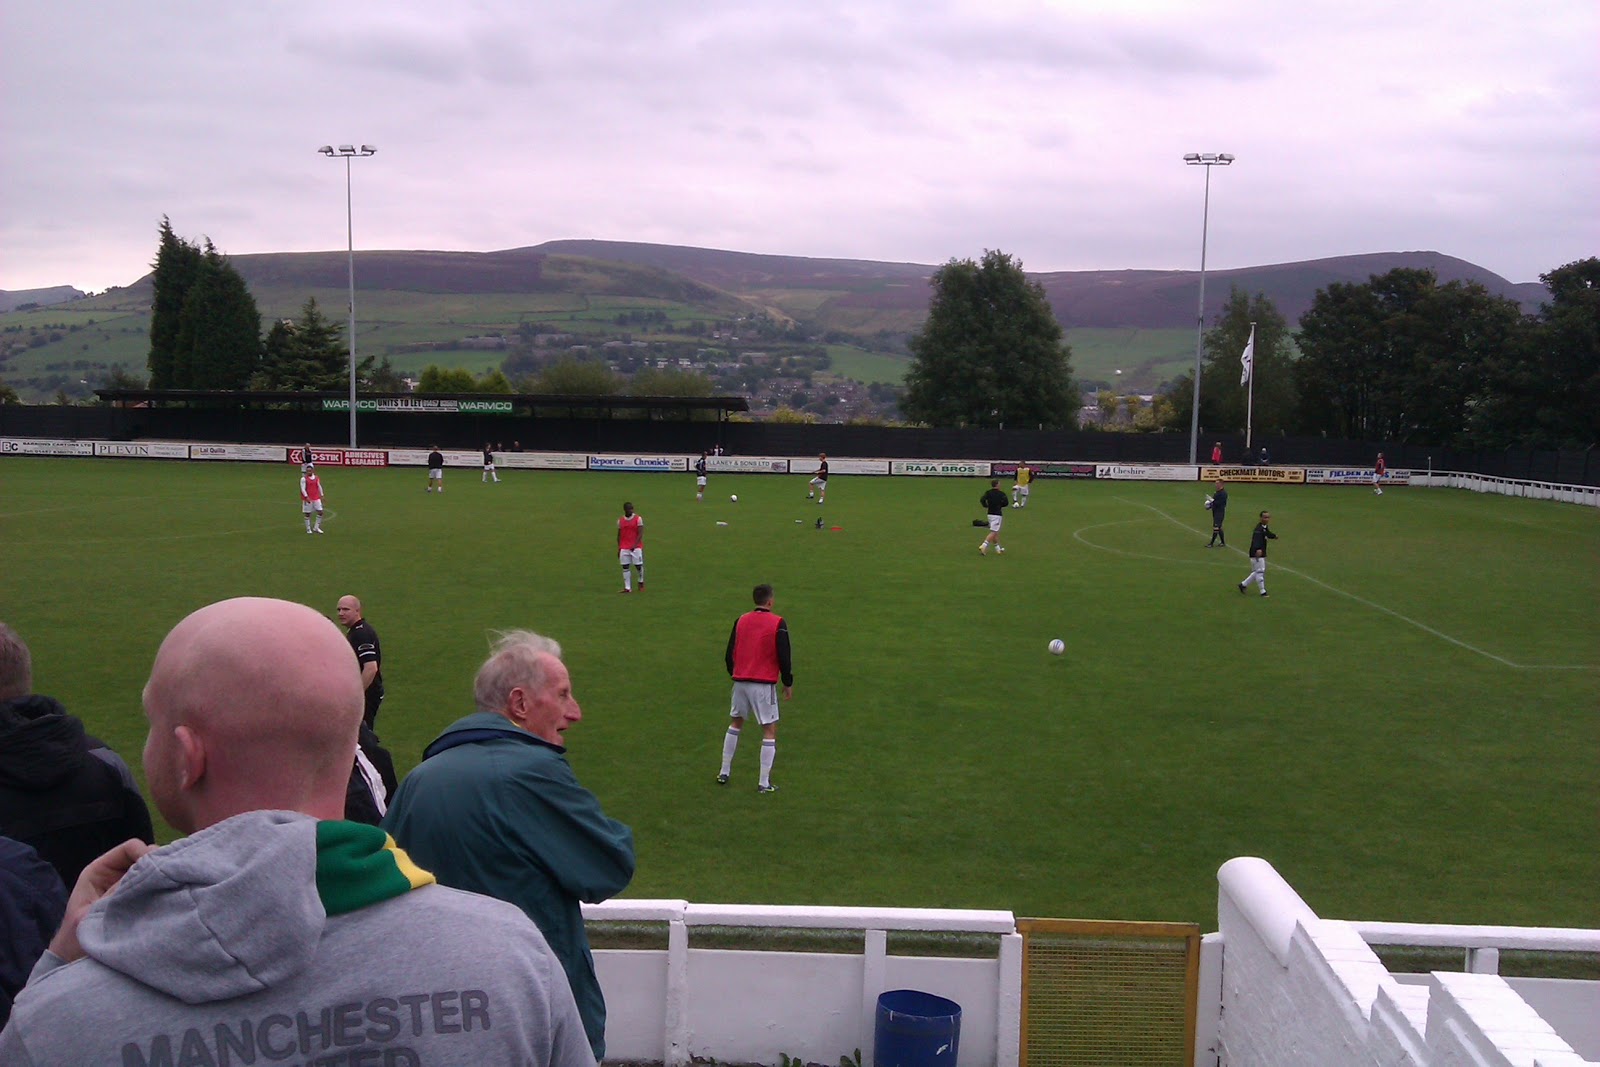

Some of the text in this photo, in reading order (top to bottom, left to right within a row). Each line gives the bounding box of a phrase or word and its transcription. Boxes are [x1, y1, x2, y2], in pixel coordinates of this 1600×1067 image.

[377, 399, 398, 407] UNITS
[400, 399, 409, 407] TO
[410, 399, 422, 407] LET
[459, 401, 513, 410] WARMCO
[100, 445, 149, 455] PLEVIN
[345, 451, 385, 459] ADHESIVES
[590, 456, 625, 466] Reporter
[633, 457, 670, 466] Chronicle
[1112, 466, 1146, 475] Cheshire
[1219, 468, 1257, 477] CHECKMATE
[1258, 468, 1286, 478] MOTORS
[120, 989, 491, 1067] MANCHESTER
